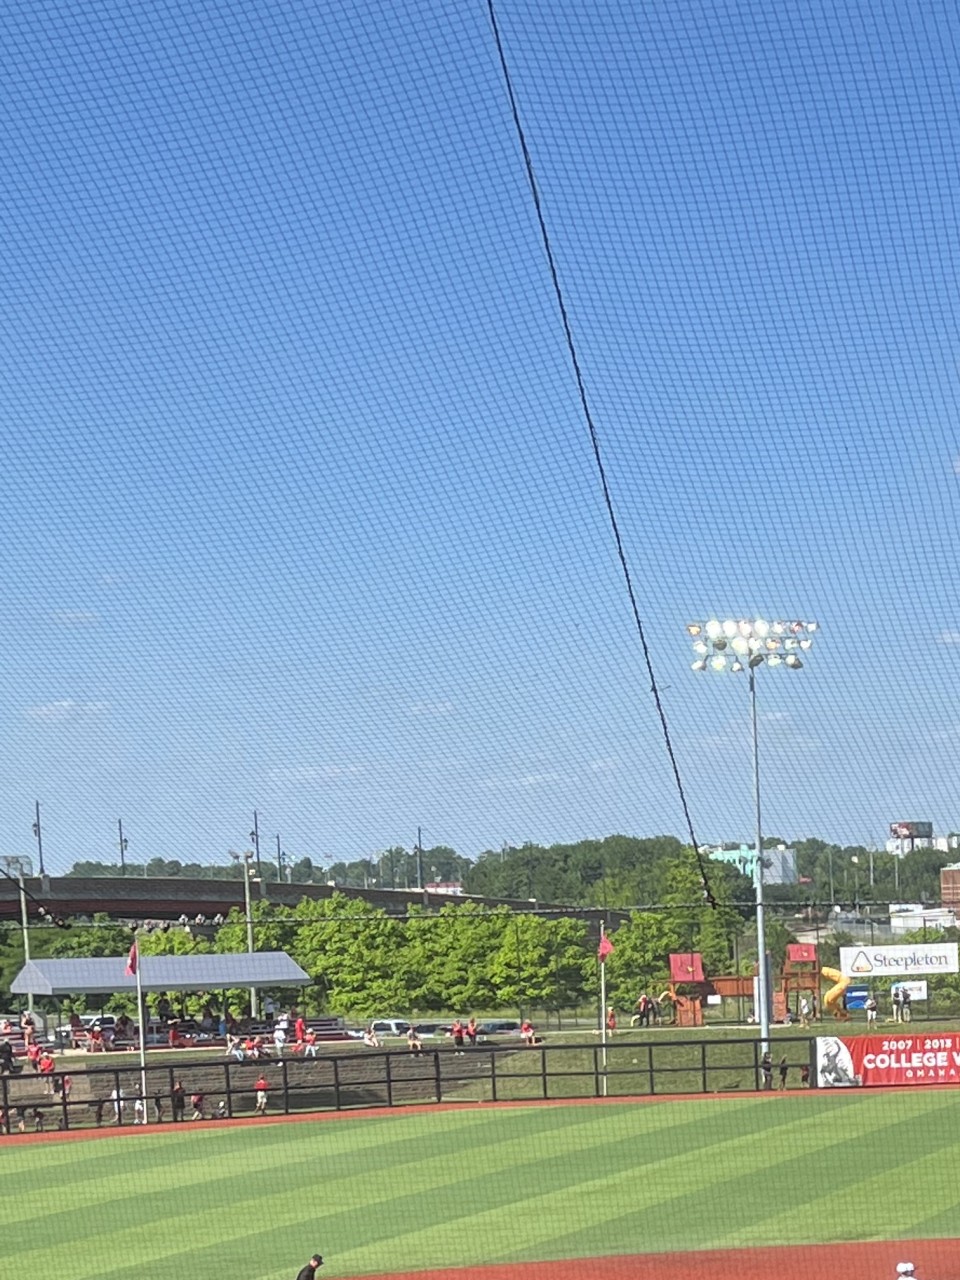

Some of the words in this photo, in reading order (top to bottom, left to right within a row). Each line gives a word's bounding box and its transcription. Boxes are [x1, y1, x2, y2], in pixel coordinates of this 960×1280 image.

[873, 952, 949, 970] Steepleton
[881, 1040, 913, 1051] 2007
[923, 1038, 952, 1050] 2013
[863, 1051, 949, 1069] COLLEGE
